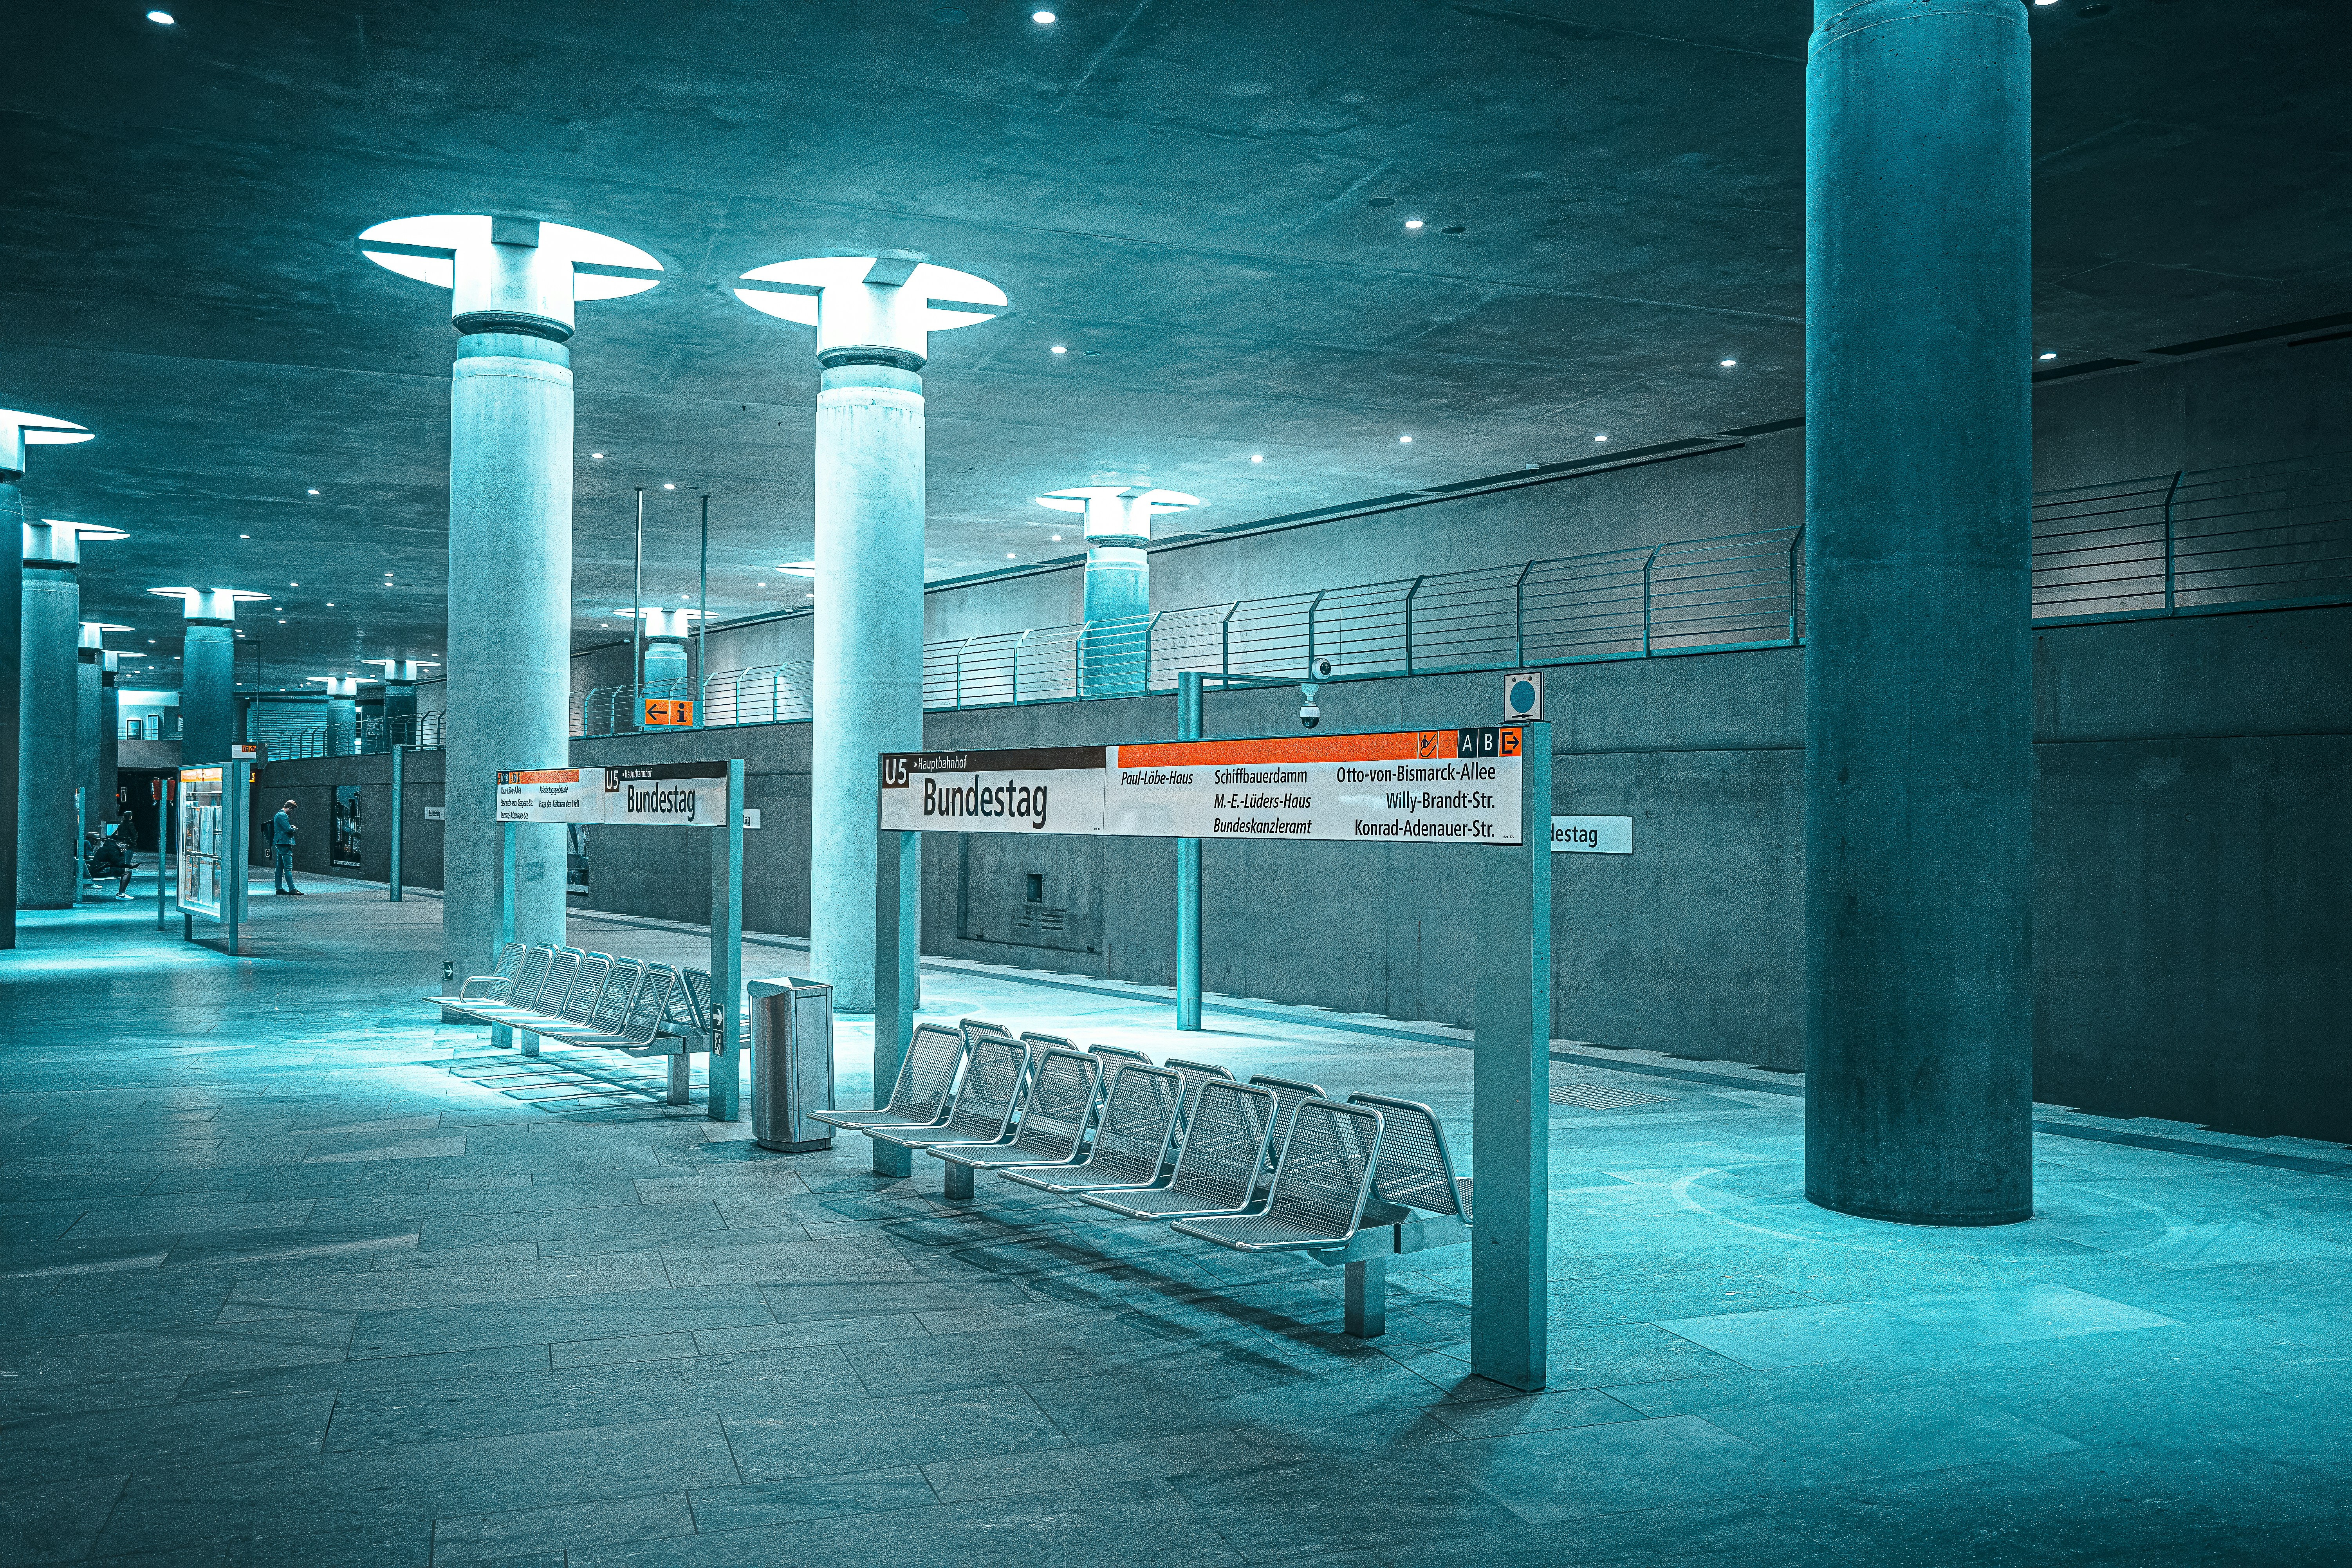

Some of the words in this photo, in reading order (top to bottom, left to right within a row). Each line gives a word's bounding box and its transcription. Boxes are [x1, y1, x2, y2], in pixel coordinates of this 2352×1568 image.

[1462, 734, 1473, 752] A
[1484, 733, 1492, 751] B
[885, 758, 908, 784] U5
[918, 755, 968, 772] Hauptbahnhof
[1121, 770, 1193, 785] Paul-Löbe-Haus
[1215, 767, 1307, 784] Schiffbauerdamm
[1336, 762, 1496, 783] Otto-von-Bismarck-Allee
[607, 770, 619, 790] U5
[628, 781, 695, 822] Bundestag
[924, 774, 1047, 829] Bundestag
[1214, 793, 1311, 808] M.-E.-Lüders-Haus
[1386, 790, 1495, 813] Willy-Brandt-Str.
[1213, 817, 1312, 834] Bundeskanzleramt
[1355, 819, 1495, 838] Konrad-Adenauer-Str.
[1551, 823, 1597, 848] estag
